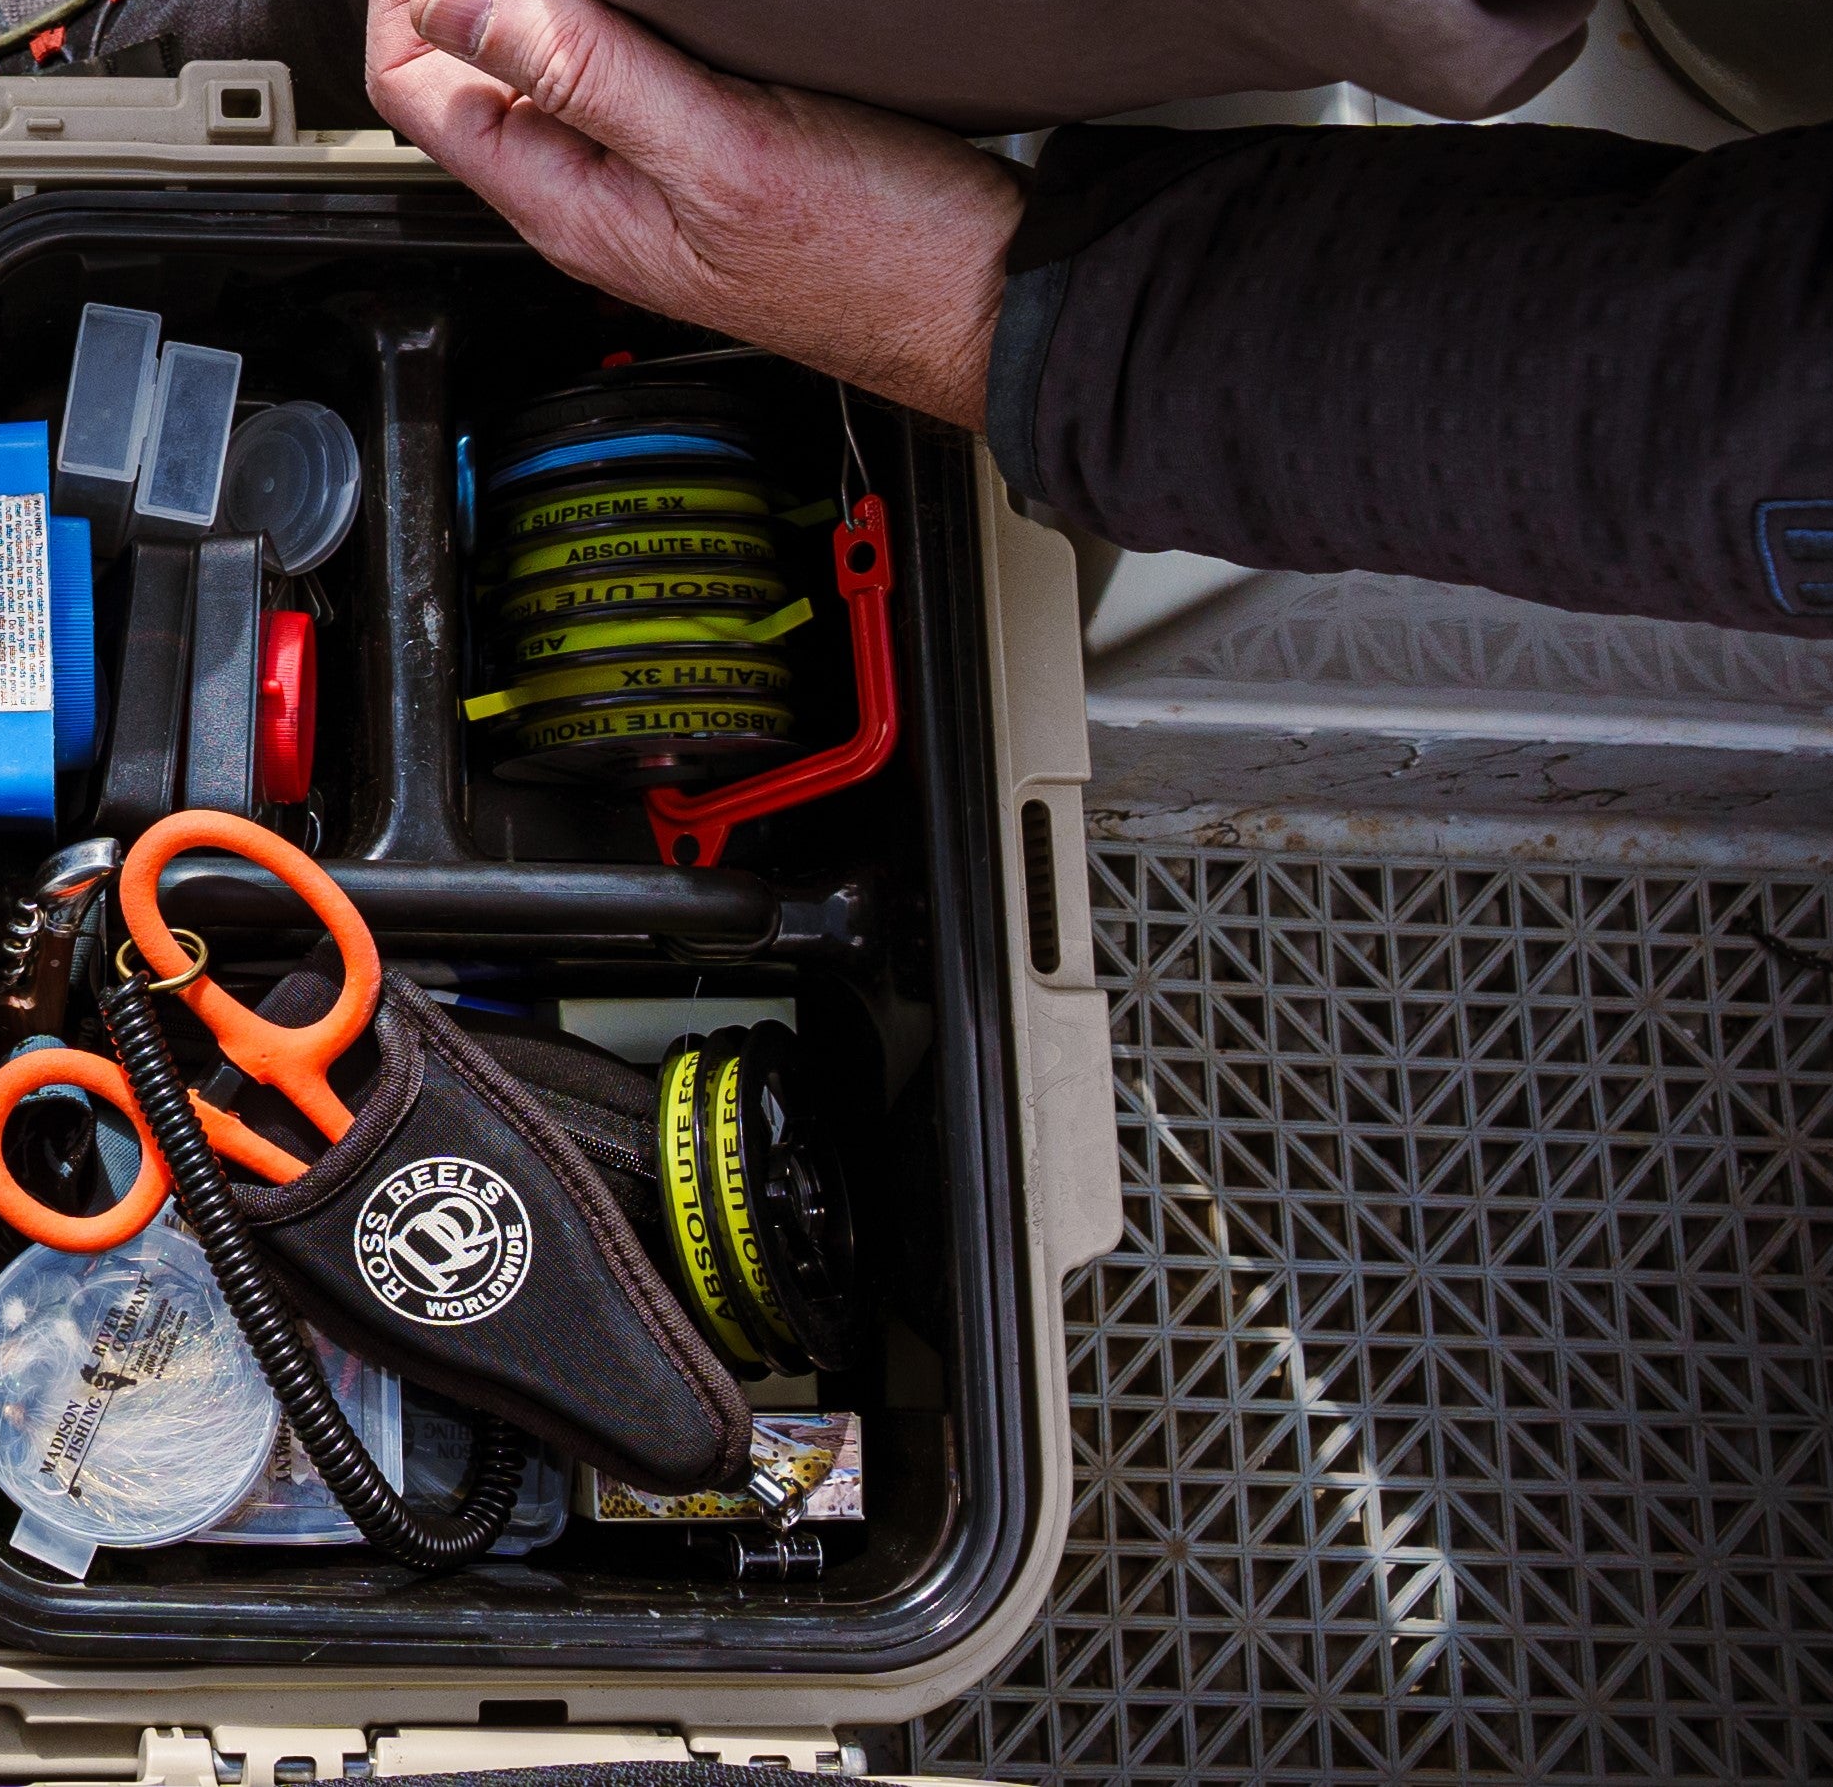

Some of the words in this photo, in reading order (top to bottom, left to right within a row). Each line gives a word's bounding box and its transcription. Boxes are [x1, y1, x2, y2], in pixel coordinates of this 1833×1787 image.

[33, 499, 43, 539] WARNING:
[532, 497, 648, 530] SUPREME
[656, 496, 687, 510] 3X
[6, 523, 14, 539] after
[14, 520, 24, 564] reproductive
[5, 542, 15, 571] handling
[25, 529, 34, 563] California
[35, 542, 43, 556] This
[565, 538, 694, 564] ABSOLUTE
[701, 538, 728, 553] FC
[7, 574, 15, 584] the
[35, 559, 45, 585] product
[17, 590, 25, 600] Do
[26, 575, 34, 598] cause
[556, 582, 768, 608] ABSOLUTE
[27, 600, 35, 625] cancer
[36, 588, 45, 617] contains
[9, 619, 17, 629] Do
[17, 616, 26, 636] place
[28, 627, 37, 641] and
[9, 632, 17, 643] not
[18, 638, 26, 654] your
[38, 626, 46, 658] chemical
[29, 643, 37, 660] birth
[19, 657, 27, 678] hands
[29, 663, 37, 688] defects
[622, 668, 662, 686] 3X
[674, 666, 786, 687] STEALTH
[627, 711, 777, 732] ABSOLUTE
[679, 1073, 695, 1104] FC
[724, 1088, 738, 1125] FC
[677, 1115, 742, 1325] ABSOLUTE
[724, 1137, 789, 1325] ABSOLUTE
[362, 1211, 407, 1302] ROSS
[386, 1164, 504, 1205] REELS
[425, 1223, 524, 1317] WORLDWIDE
[67, 1395, 103, 1465] FISHING
[112, 1272, 155, 1354] COMPANY
[144, 1350, 157, 1375] 800
[39, 1400, 84, 1478] MADISON
[92, 1304, 123, 1360] RIVER
